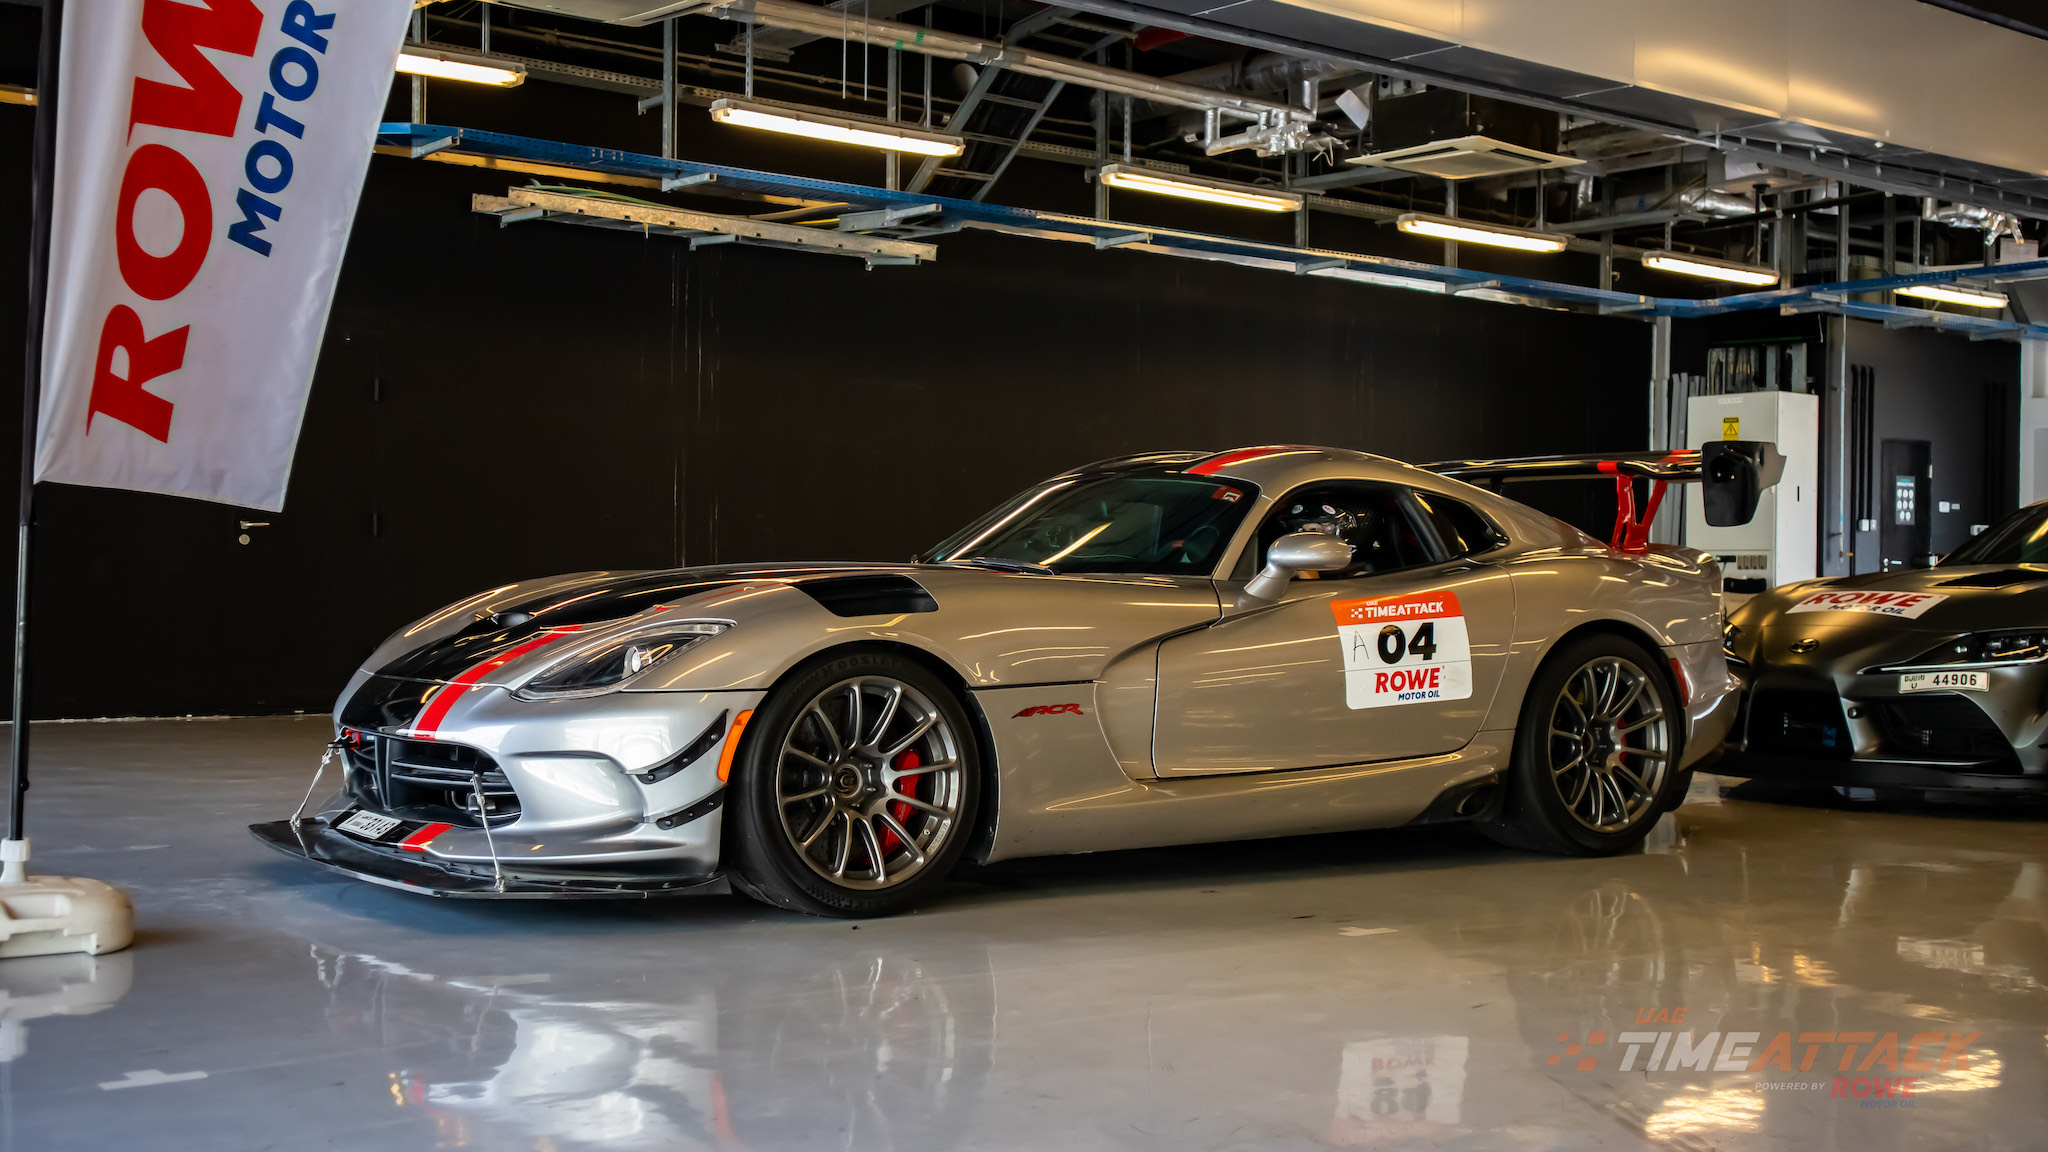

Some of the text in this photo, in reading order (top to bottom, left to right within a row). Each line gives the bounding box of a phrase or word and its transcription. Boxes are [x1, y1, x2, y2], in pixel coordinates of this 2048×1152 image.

[227, 0, 337, 258] MOTOR
[1802, 593, 1933, 607] ROWE
[1365, 601, 1444, 618] TIMEATTACK
[1882, 607, 1905, 615] OIL
[1353, 631, 1369, 662] A
[1377, 622, 1437, 664] 04
[1374, 667, 1440, 693] ROWE
[1932, 674, 1977, 685] 44906
[1398, 690, 1440, 701] MOTOR OIL
[1011, 703, 1084, 719] ACR
